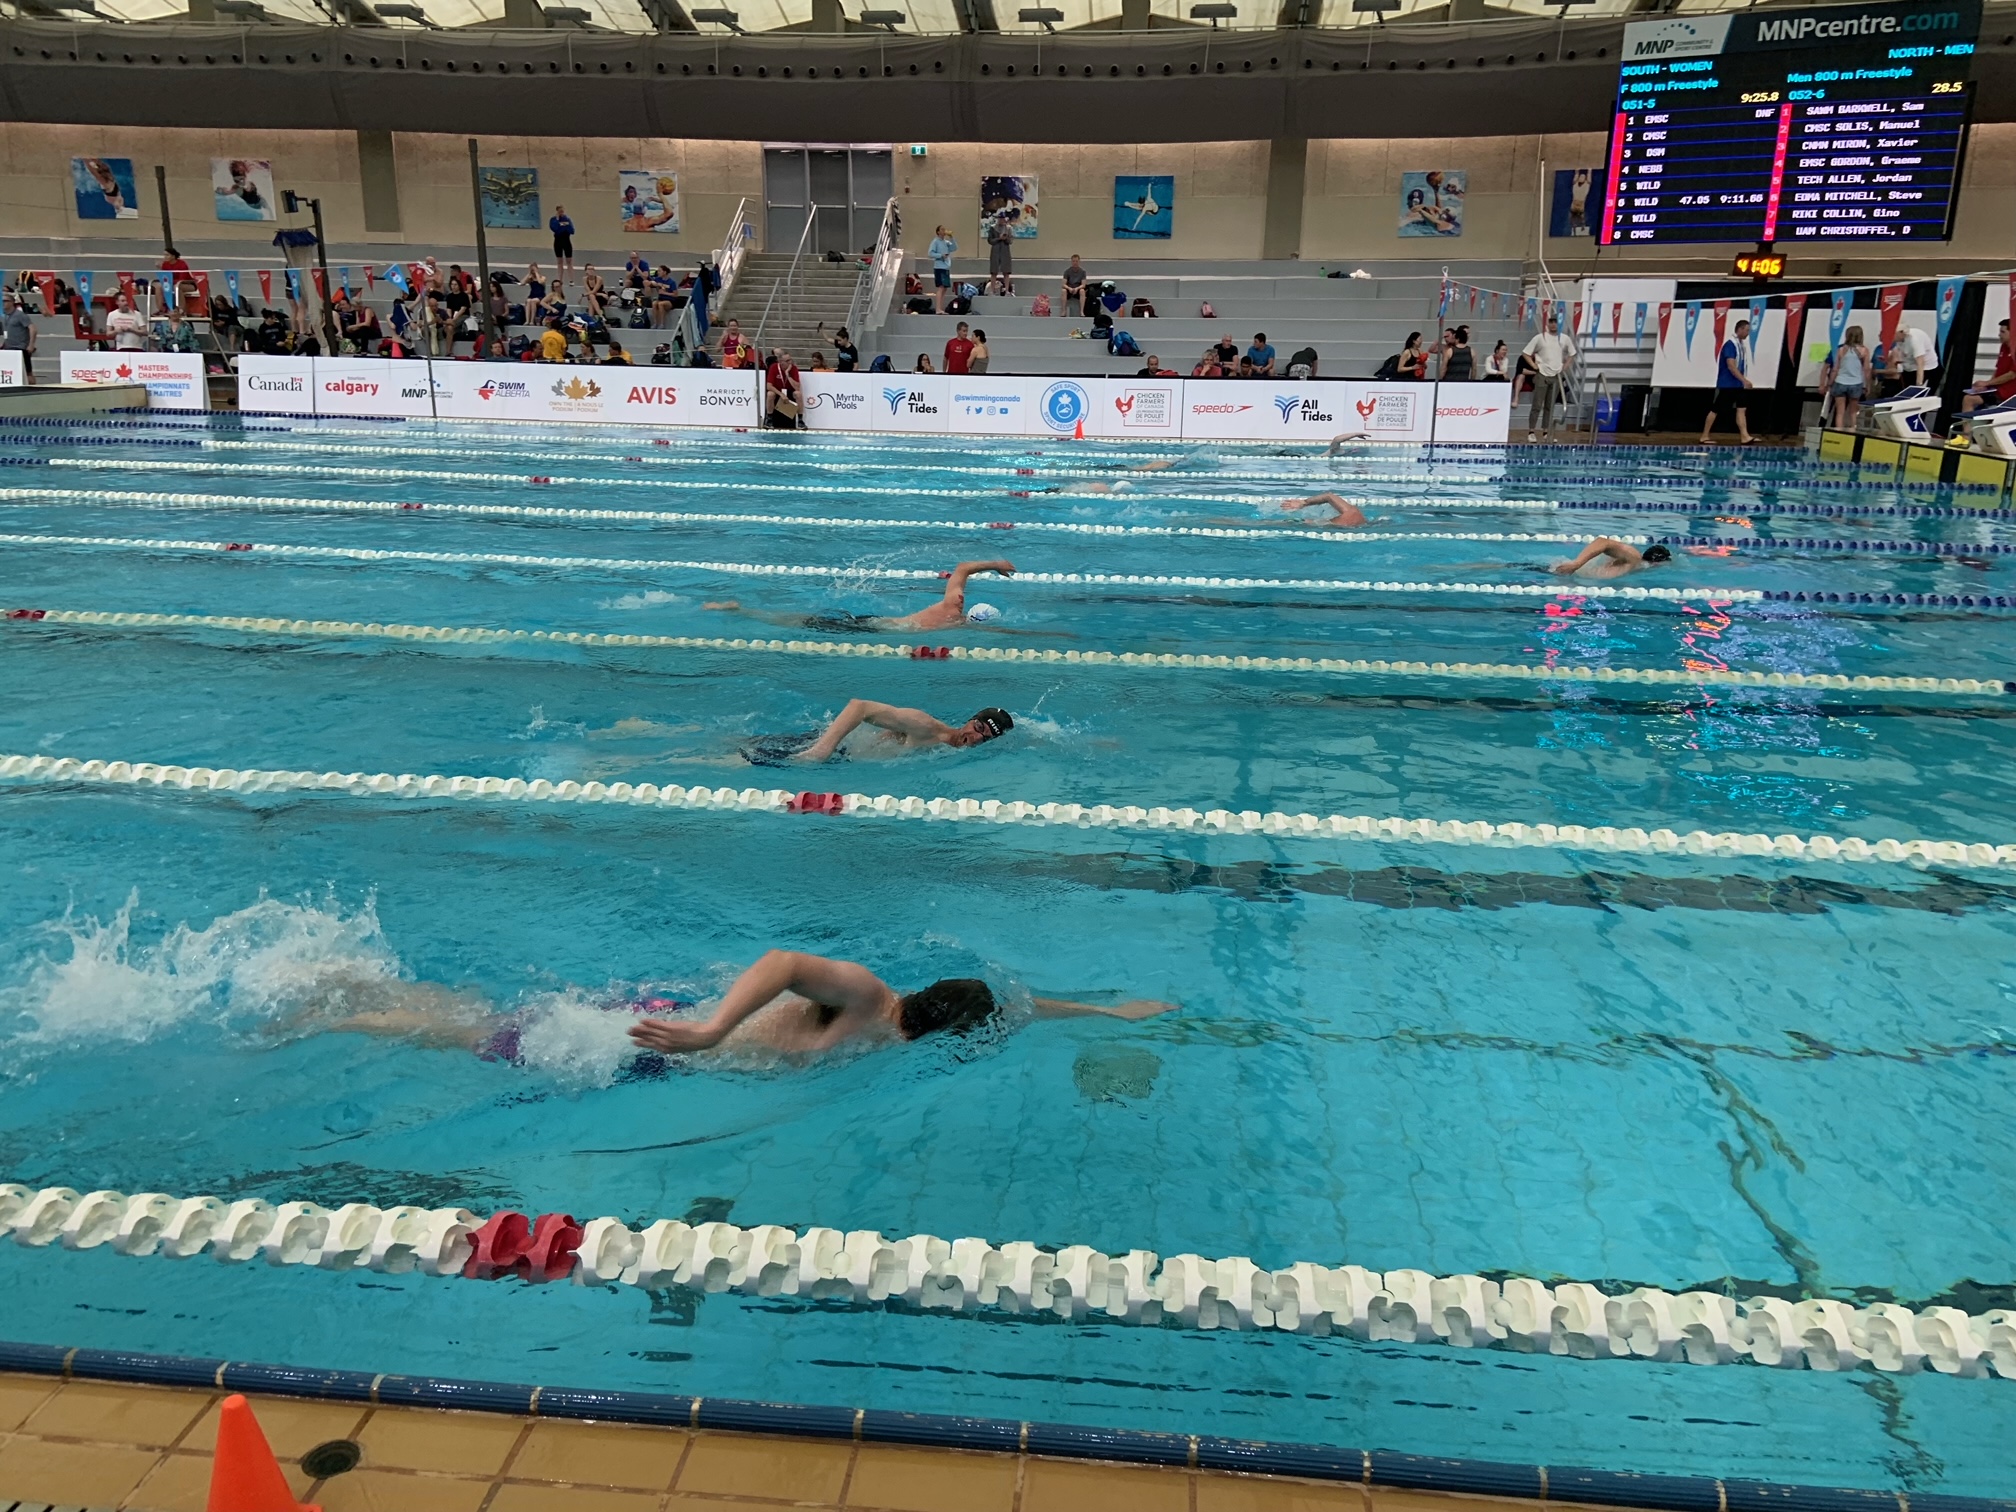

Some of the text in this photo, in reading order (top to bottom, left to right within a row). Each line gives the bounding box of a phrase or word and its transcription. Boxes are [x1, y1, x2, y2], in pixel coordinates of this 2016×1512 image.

[1757, 11, 1959, 42] MNPcentre.com
[1634, 40, 1675, 55] MNP
[1888, 47, 1934, 59] NORTH
[1944, 44, 1974, 56] MEN
[1621, 65, 1660, 76] SOUTH
[1669, 61, 1713, 73] WOMEN
[1787, 67, 1913, 83] Men 800 m Freestyle
[1621, 84, 1629, 93] F
[1630, 82, 1652, 93] 800
[1667, 78, 1719, 91] Freestyle
[1931, 81, 1963, 94] 28.5
[1740, 92, 1780, 103] 9:25.8
[1788, 89, 1825, 100] 052-6
[1622, 99, 1656, 110] 051-5
[1755, 108, 1775, 118] DNF
[1627, 114, 1669, 125] 1 EMSC
[1804, 123, 1831, 133] CMSC
[1879, 120, 1920, 130] Manuel
[1625, 131, 1667, 142] 2 CMSC
[1877, 138, 1919, 148] Xavier
[1624, 149, 1631, 158] 3
[1799, 158, 1826, 167] EMSC
[1881, 156, 1922, 165] Graeme
[1622, 165, 1629, 174] 4
[1797, 175, 1823, 184] TECH
[1827, 174, 1866, 184] ALLEN,
[1872, 174, 1912, 183] Jordan
[1620, 181, 1661, 191] 5 WILD
[1634, 197, 1658, 207] WILD
[1679, 195, 1710, 205] 47.05
[1825, 191, 1882, 202] MITCHELL,
[1888, 191, 1922, 200] Steve
[1616, 213, 1656, 223] 7 WILD
[1873, 209, 1900, 218] Gino
[1613, 231, 1621, 239] 8
[1737, 259, 1781, 275] 41:06
[138, 372, 192, 380] CHAMPIONSHIPS
[248, 375, 303, 392] Canada
[325, 379, 379, 396] calgary
[498, 382, 525, 390] SWIM
[401, 388, 427, 398] MNP
[494, 390, 530, 398] ALBERTA
[626, 386, 677, 405] AVIS
[836, 393, 864, 403] Myrtha
[908, 392, 924, 402] All
[954, 394, 1021, 403] @swimmingcanada
[700, 395, 752, 406] BONVOY
[836, 401, 857, 410] Pools
[1302, 399, 1318, 410] All
[908, 403, 938, 414] Tides
[1192, 403, 1234, 415] speedo
[1435, 406, 1479, 418] speedo
[1301, 411, 1333, 421] Tides
[1912, 418, 1919, 430] 1
